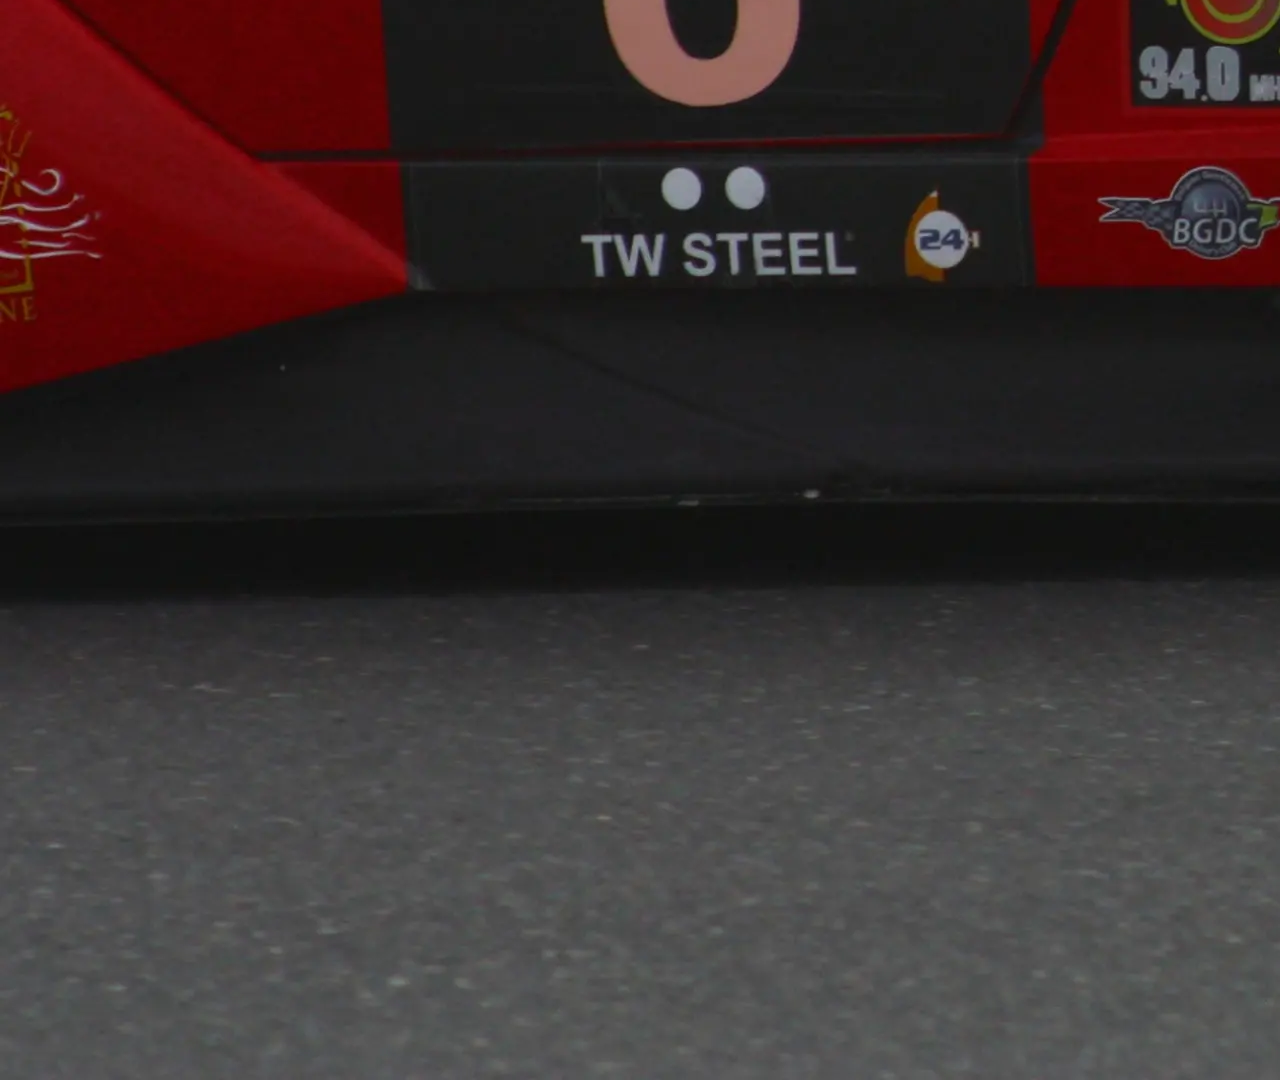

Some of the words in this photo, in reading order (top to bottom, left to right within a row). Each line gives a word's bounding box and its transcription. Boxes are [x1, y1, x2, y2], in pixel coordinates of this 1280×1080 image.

[1139, 45, 1241, 102] 94.0
[1172, 218, 1259, 244] BGDC
[581, 232, 665, 276] TW
[682, 232, 857, 276] STEEL
